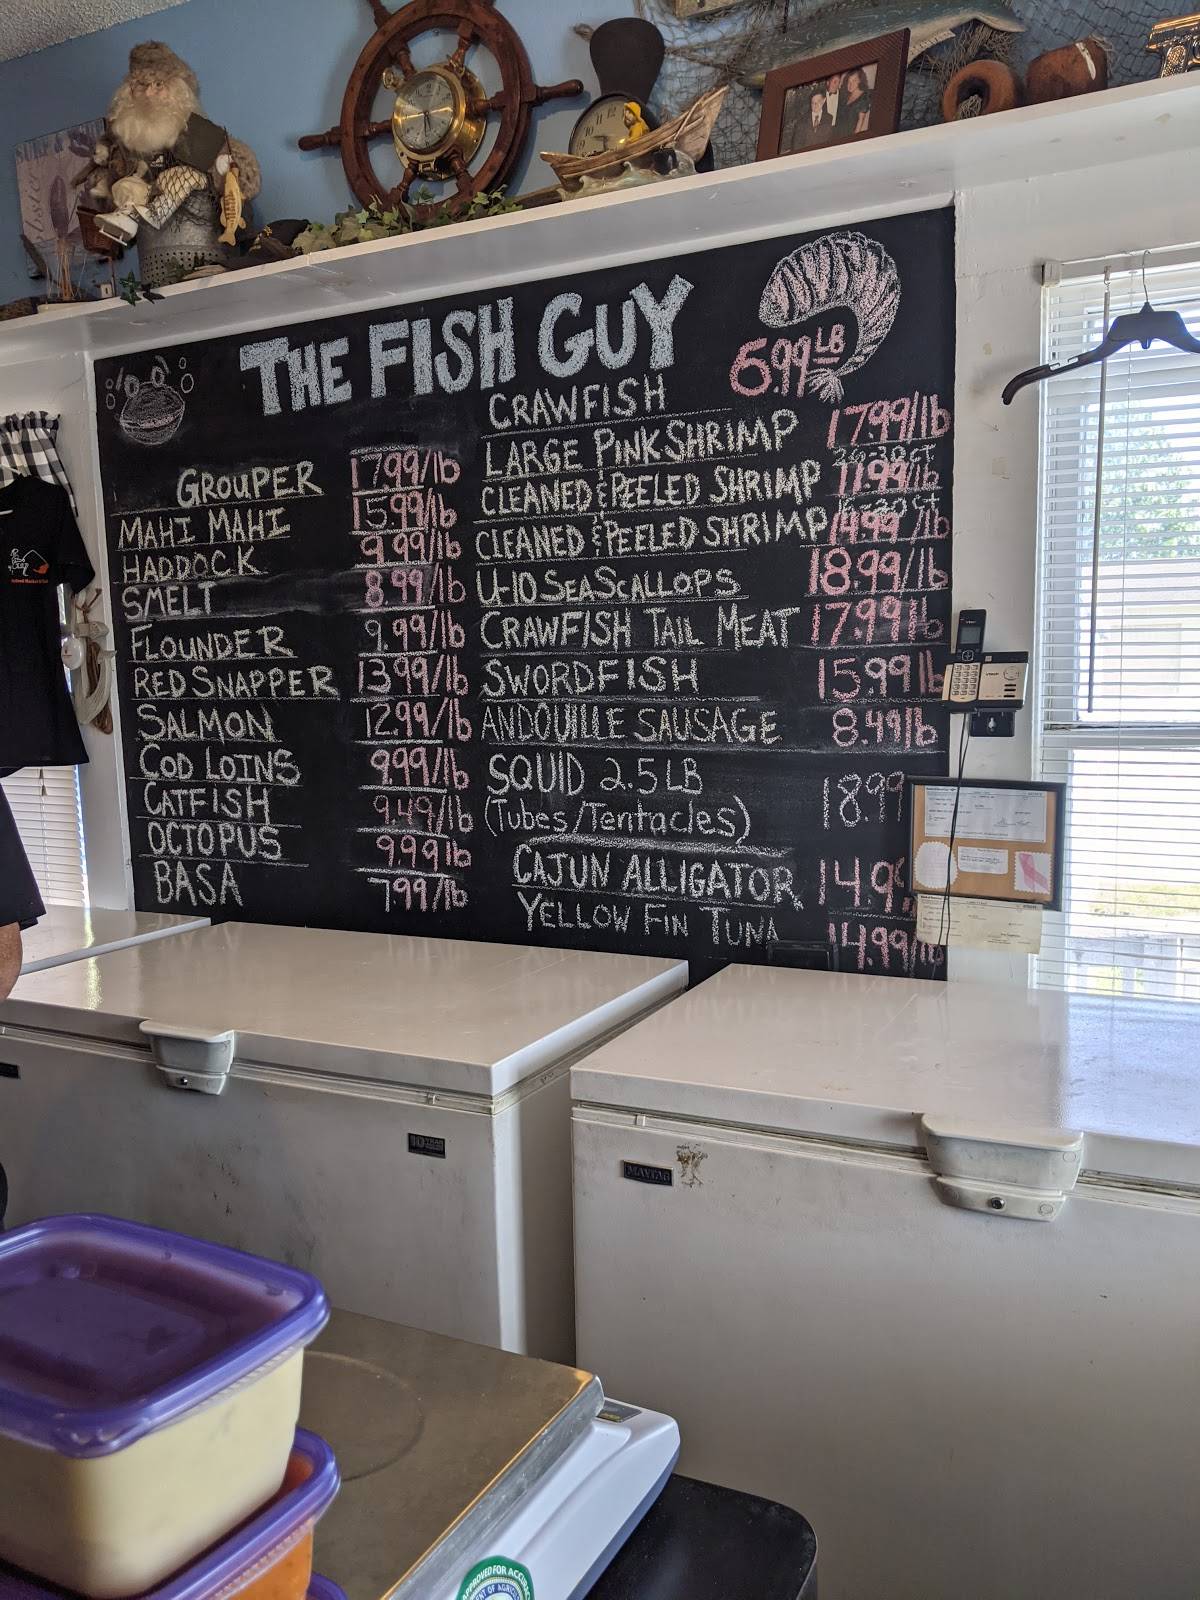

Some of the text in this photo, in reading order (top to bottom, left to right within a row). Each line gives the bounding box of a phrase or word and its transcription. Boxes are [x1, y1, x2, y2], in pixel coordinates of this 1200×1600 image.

[240, 274, 694, 416] THE FISH GUY
[729, 324, 845, 397] 6.99 LB
[489, 373, 665, 430] CRAWFISH
[485, 409, 799, 477] LARGE PINK SHRIMP
[176, 461, 323, 507] GROUPER
[482, 478, 593, 515] CLEANED
[611, 470, 700, 509] PEELED
[709, 460, 821, 505] SHRIMP
[118, 507, 291, 549] MAHI MAHI
[475, 524, 585, 560] CLEANED
[604, 516, 699, 555] PEELED
[703, 506, 827, 548] SHRIMP
[123, 545, 262, 583] HADDOCK
[122, 581, 217, 621] SMELT
[476, 565, 742, 606] U-10 SEA SCALLOPS
[131, 624, 294, 661] FLOUNDER
[365, 609, 465, 652] 9.99/lb
[480, 603, 800, 652] CRAWFISH TAIL MEAT
[134, 665, 340, 699] RED SNAPPER
[482, 656, 698, 697] SWORDFISH
[137, 703, 277, 744] SALMON
[481, 702, 782, 744] ANDOUILLE SAUSAGE
[139, 743, 301, 784] COD LOINS
[487, 751, 703, 796] SQUID 2.5 LB
[144, 782, 270, 824] CATFISH
[148, 821, 282, 860] OCTOPUS
[154, 860, 244, 906] BASA
[513, 843, 803, 911] CAJUN ALLIGATOR
[518, 892, 779, 946] YELLOW FIN TUNA
[493, 1564, 507, 1575] FOR
